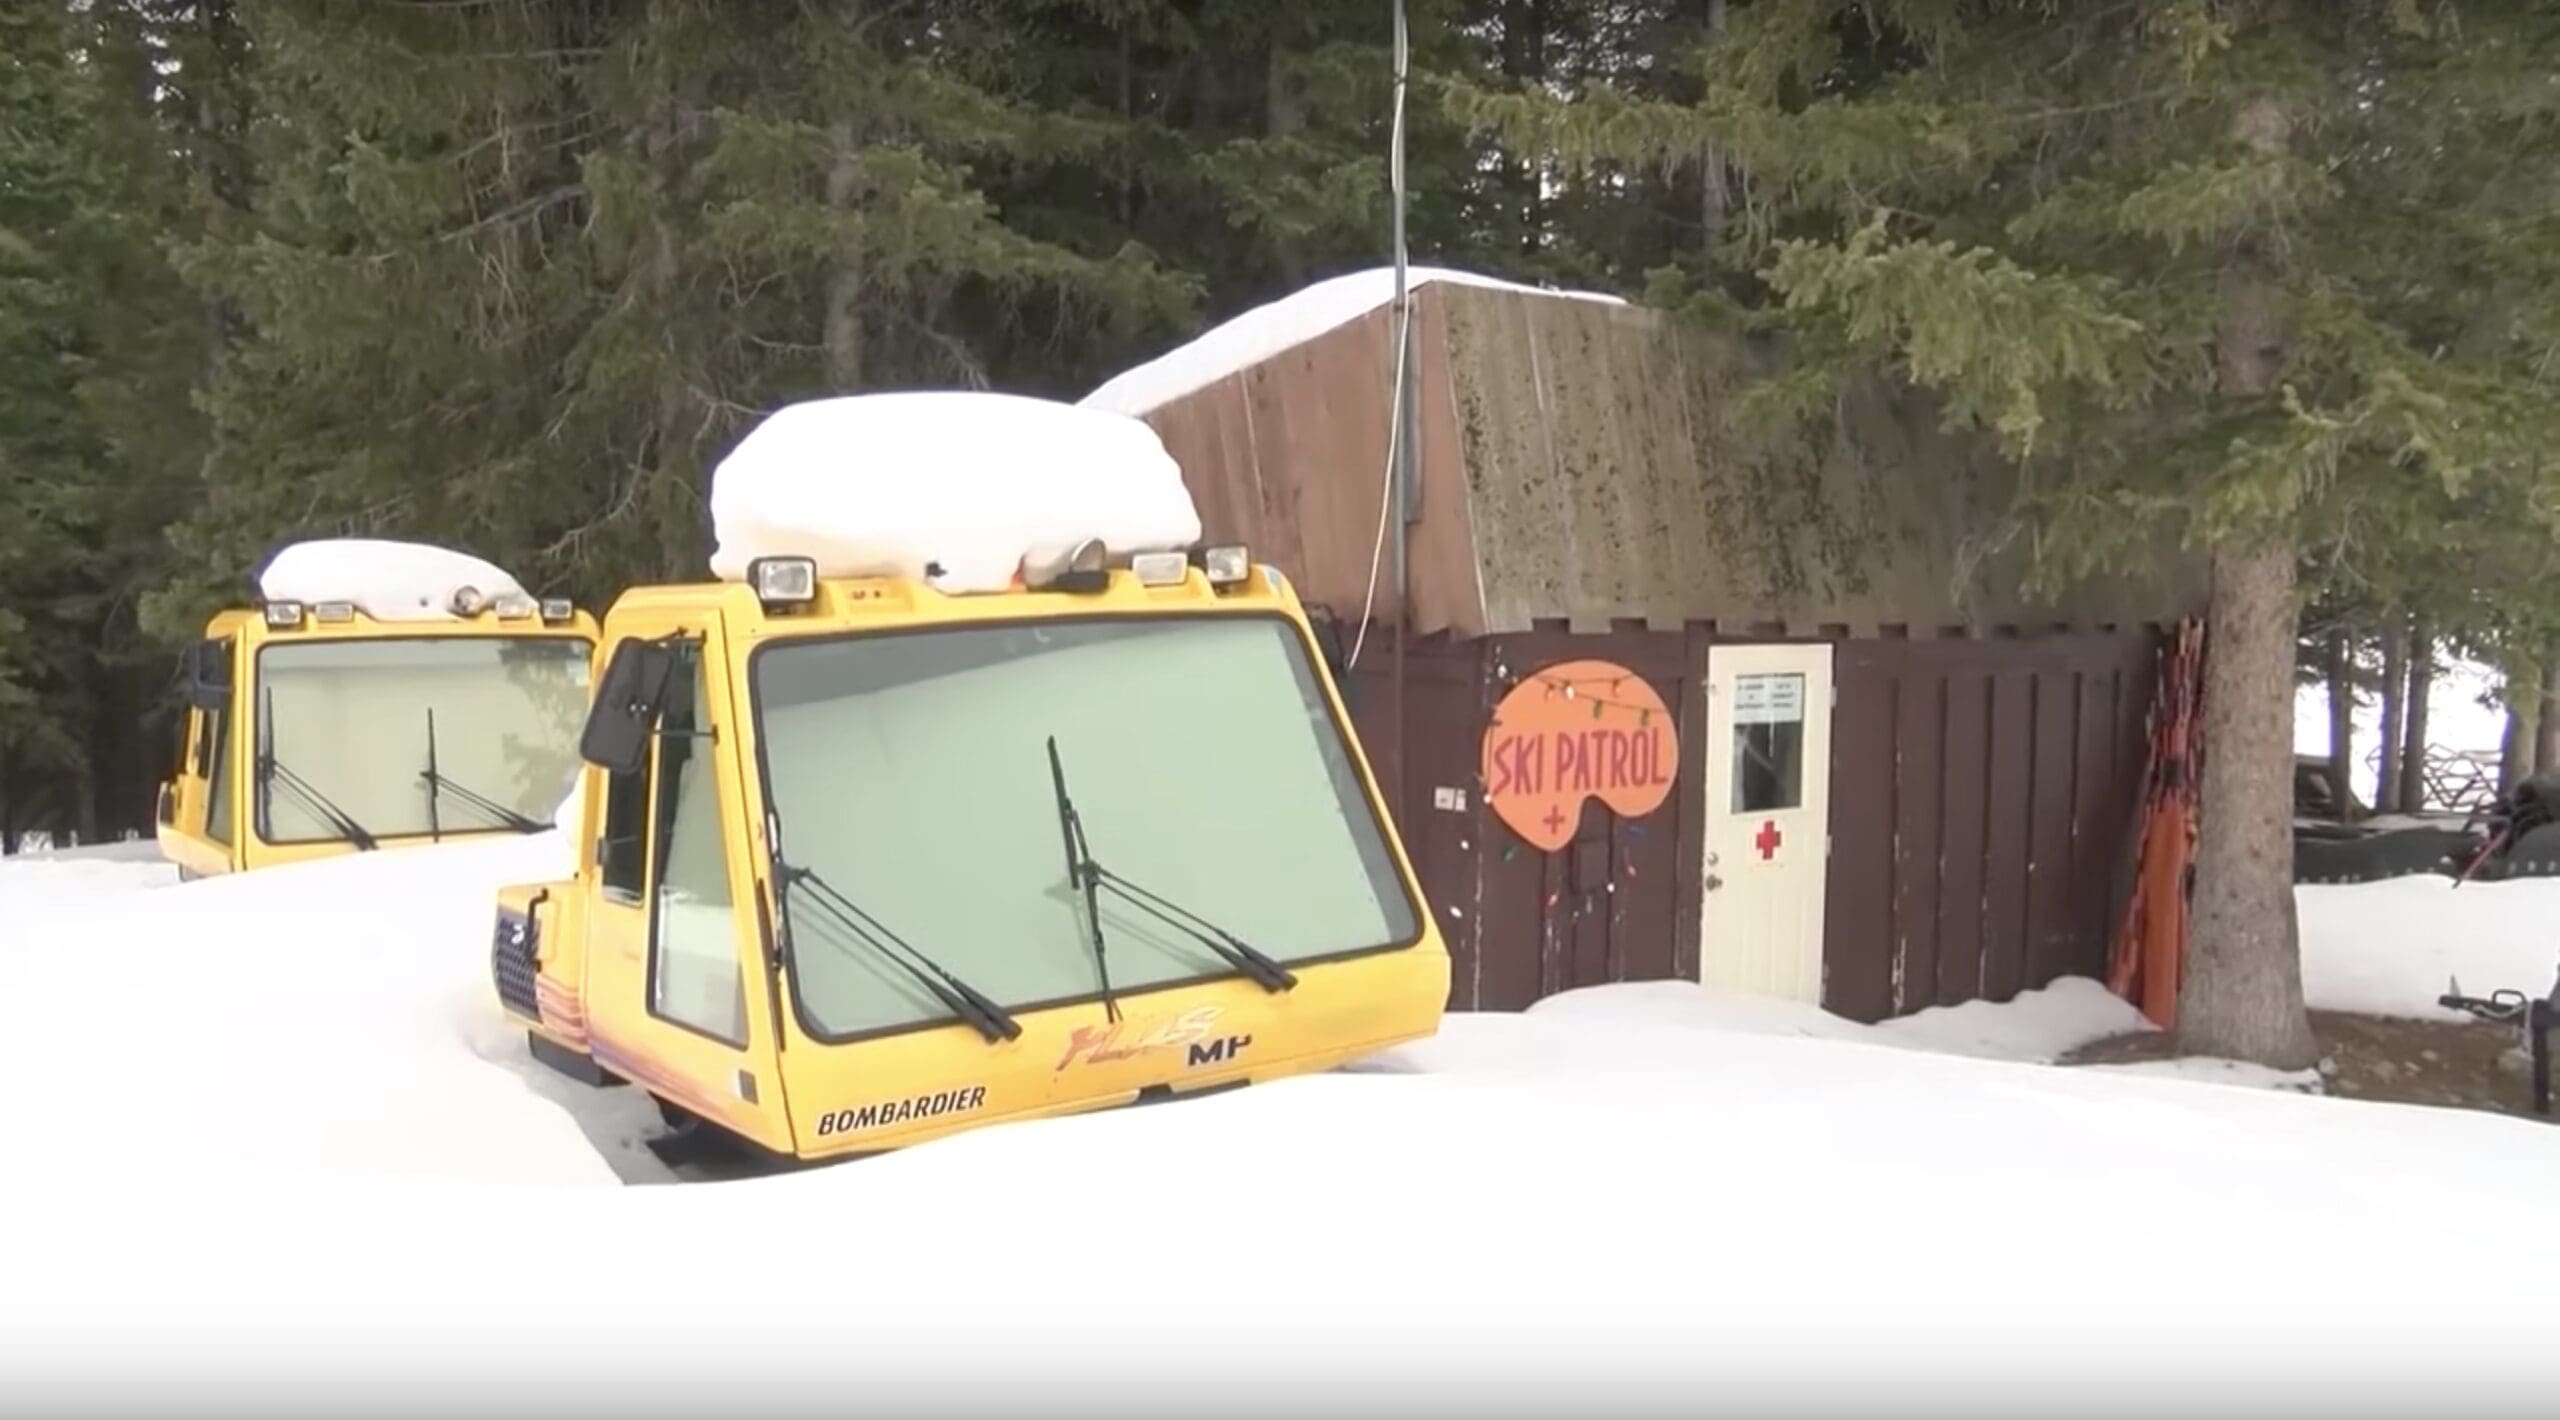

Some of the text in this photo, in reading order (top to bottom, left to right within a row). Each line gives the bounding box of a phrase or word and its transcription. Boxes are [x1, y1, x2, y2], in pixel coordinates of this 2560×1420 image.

[1493, 727, 1669, 796] SKI PATROL
[818, 1086, 986, 1136] BOMBARDIER
